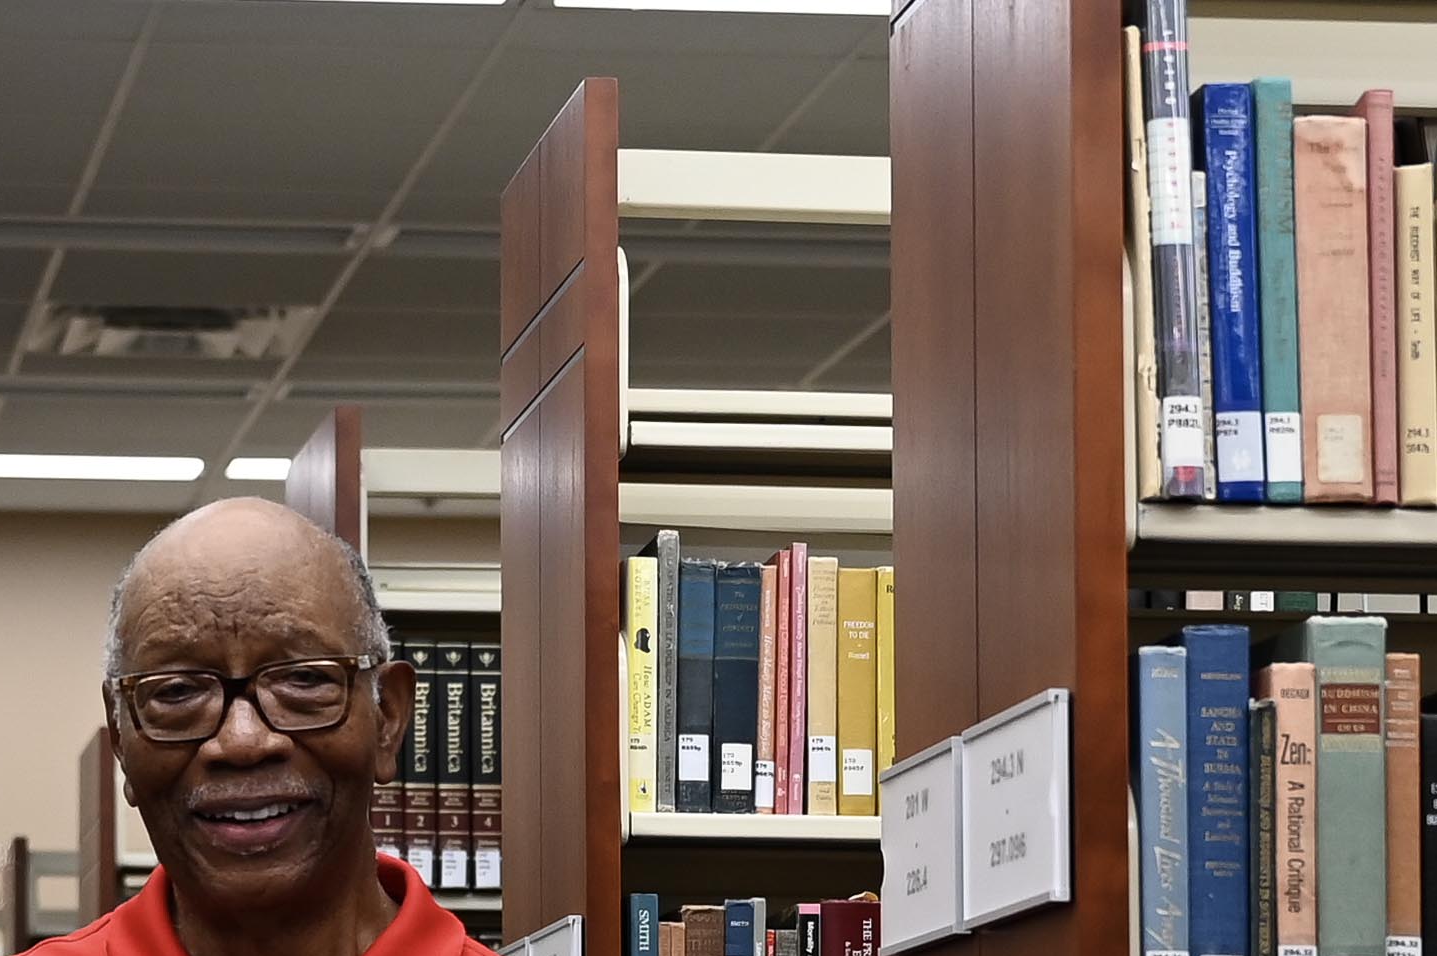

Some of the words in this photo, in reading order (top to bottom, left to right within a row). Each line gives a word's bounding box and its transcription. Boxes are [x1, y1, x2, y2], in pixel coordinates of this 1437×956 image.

[1222, 149, 1240, 221] Psychology
[1226, 223, 1240, 246] and
[1227, 248, 1243, 313] Buddhism
[848, 631, 858, 639] TO
[643, 692, 652, 728] ADAM
[1321, 688, 1380, 699] BUDDHISM
[1323, 704, 1337, 714] IN
[1341, 704, 1379, 714] CHINA
[414, 681, 430, 773] Britannica
[447, 682, 463, 773] Britannica
[480, 683, 497, 774] Britannica
[1280, 733, 1312, 766] Zen:
[1149, 755, 1186, 841] Thousand
[1287, 781, 1303, 791] A
[385, 814, 391, 826] 1
[416, 815, 425, 828] 2
[450, 815, 459, 828] 3
[484, 816, 492, 828] 4
[1286, 797, 1306, 852] Rational
[1152, 845, 1182, 891] Lives
[1285, 858, 1305, 913] Critique
[637, 909, 650, 951] SMITH
[806, 921, 815, 954] Morality
[862, 917, 873, 941] THE
